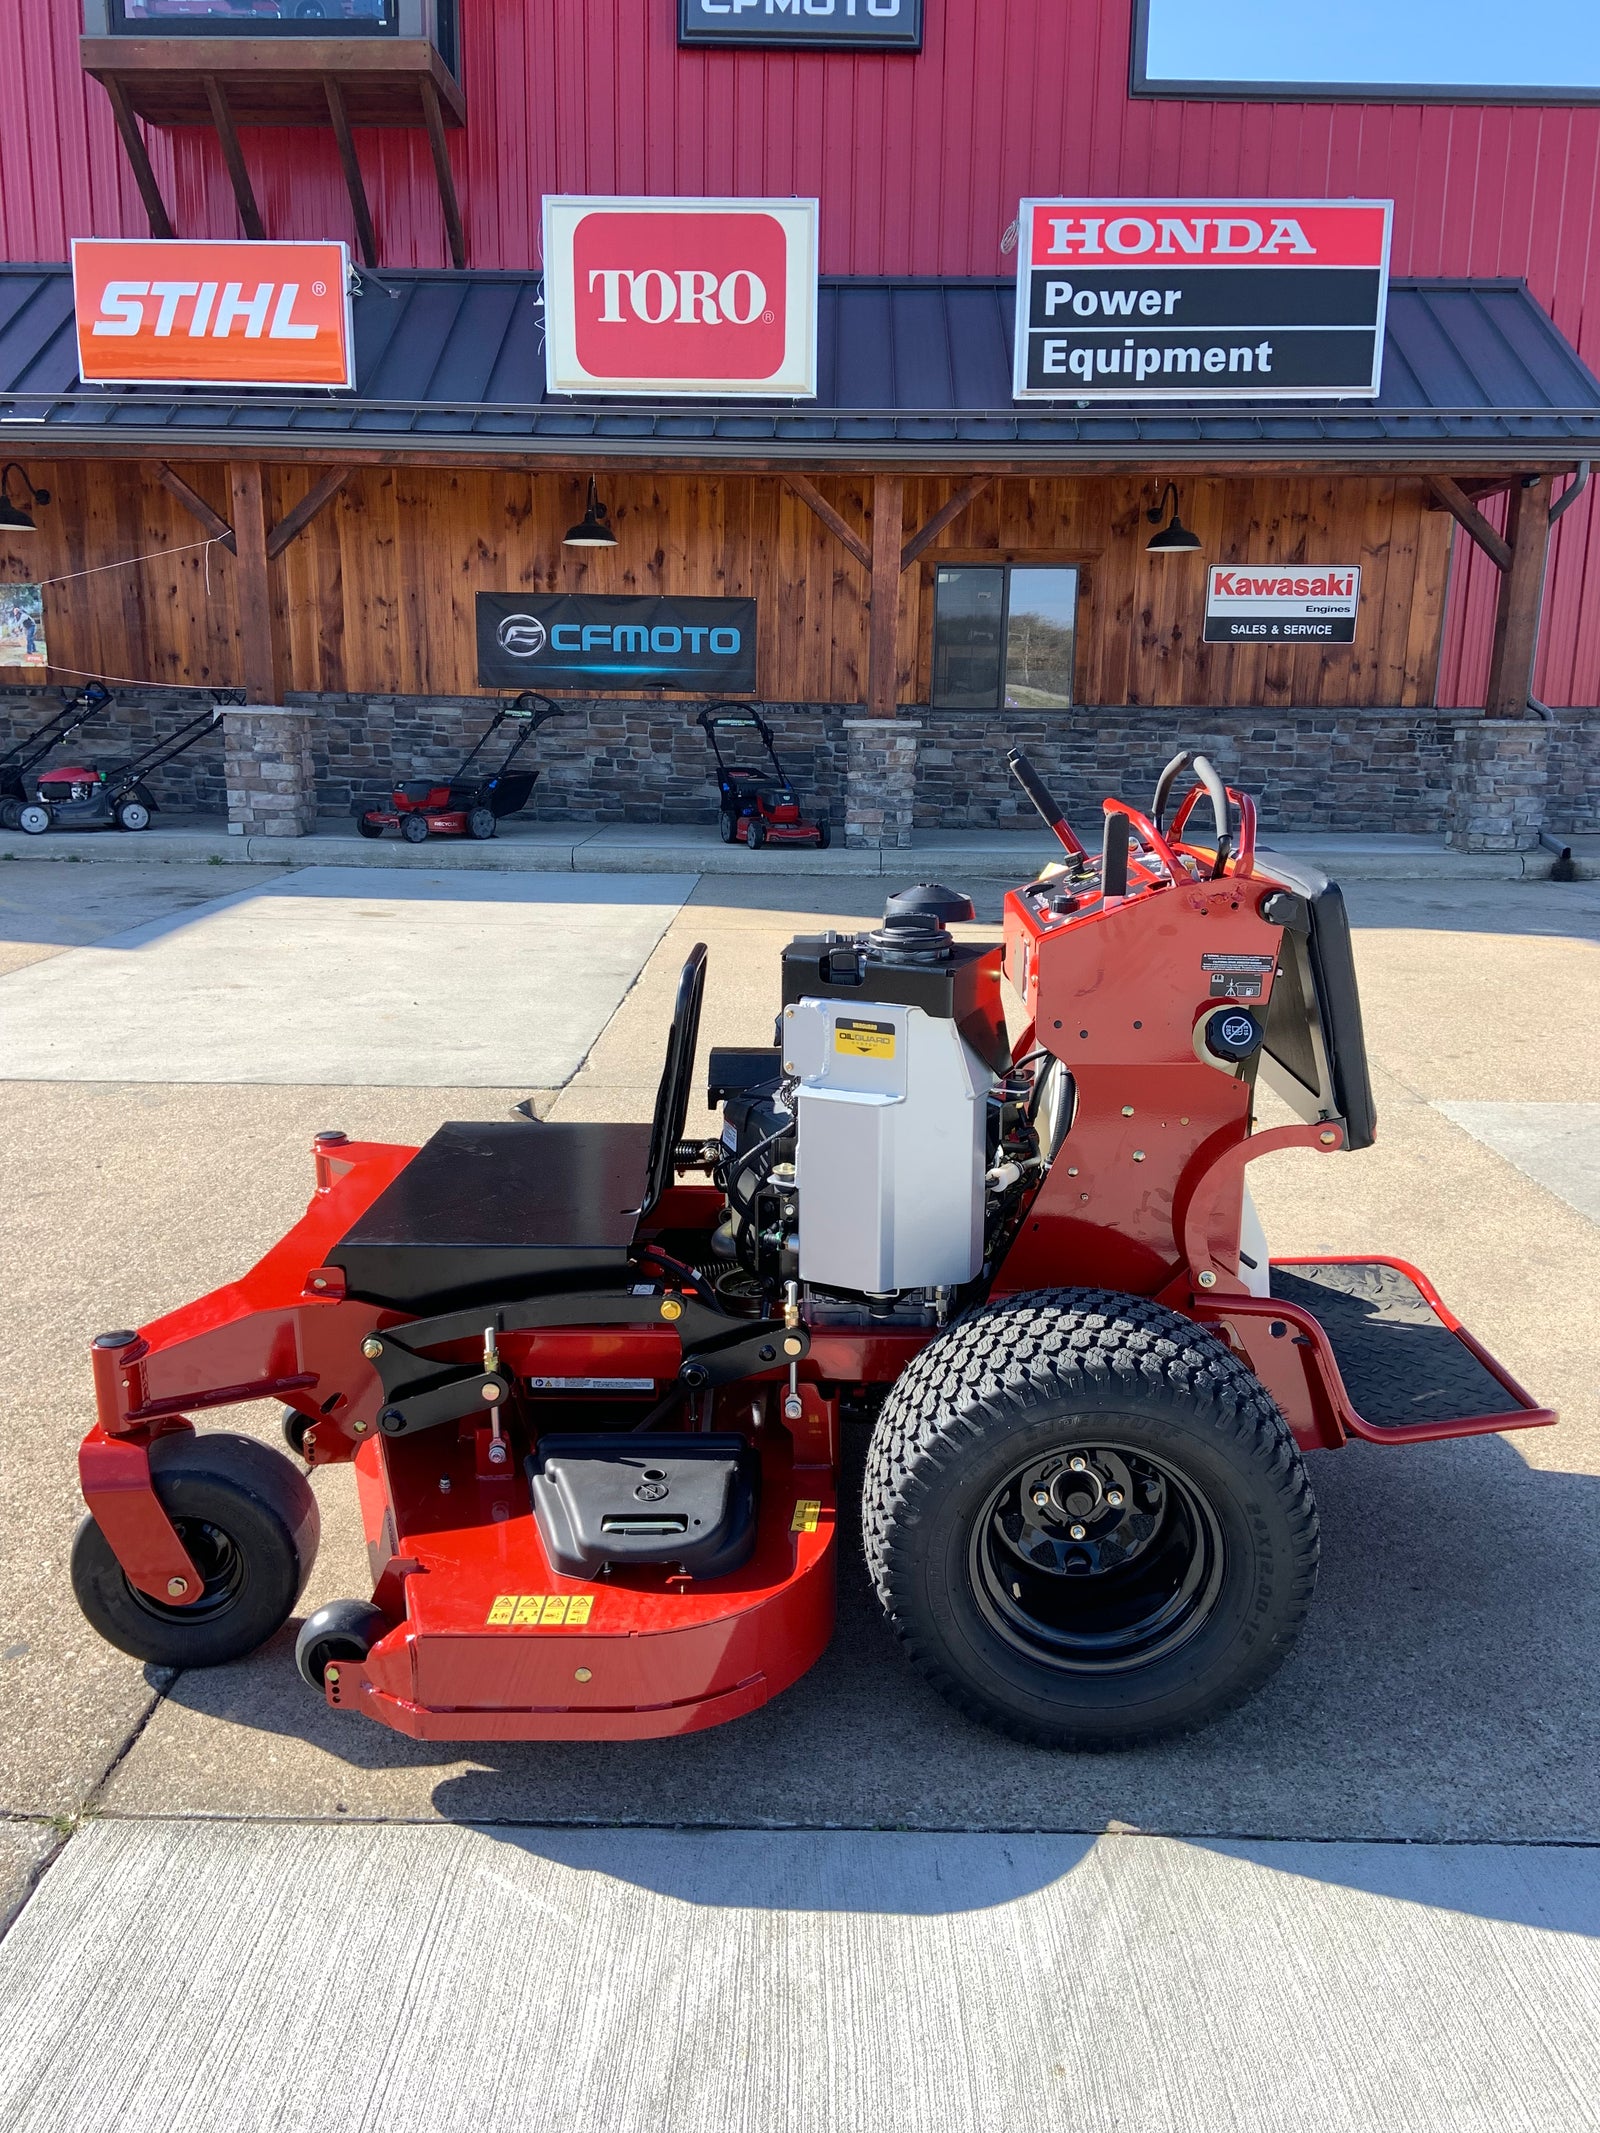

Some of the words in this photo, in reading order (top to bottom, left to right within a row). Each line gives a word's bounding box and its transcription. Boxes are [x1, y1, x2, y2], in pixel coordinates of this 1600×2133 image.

[1047, 217, 1317, 255] HONDA
[91, 281, 320, 340] STIHL
[588, 269, 768, 325] TORO
[1044, 281, 1182, 317] Power
[1042, 339, 1273, 382] Equipment
[1213, 572, 1354, 597] Kawasaki
[1305, 605, 1351, 614] Engines
[551, 624, 741, 654] CFMOTO
[1230, 624, 1267, 635] SALES
[1271, 625, 1280, 635] &
[1283, 624, 1333, 635] SERVICE
